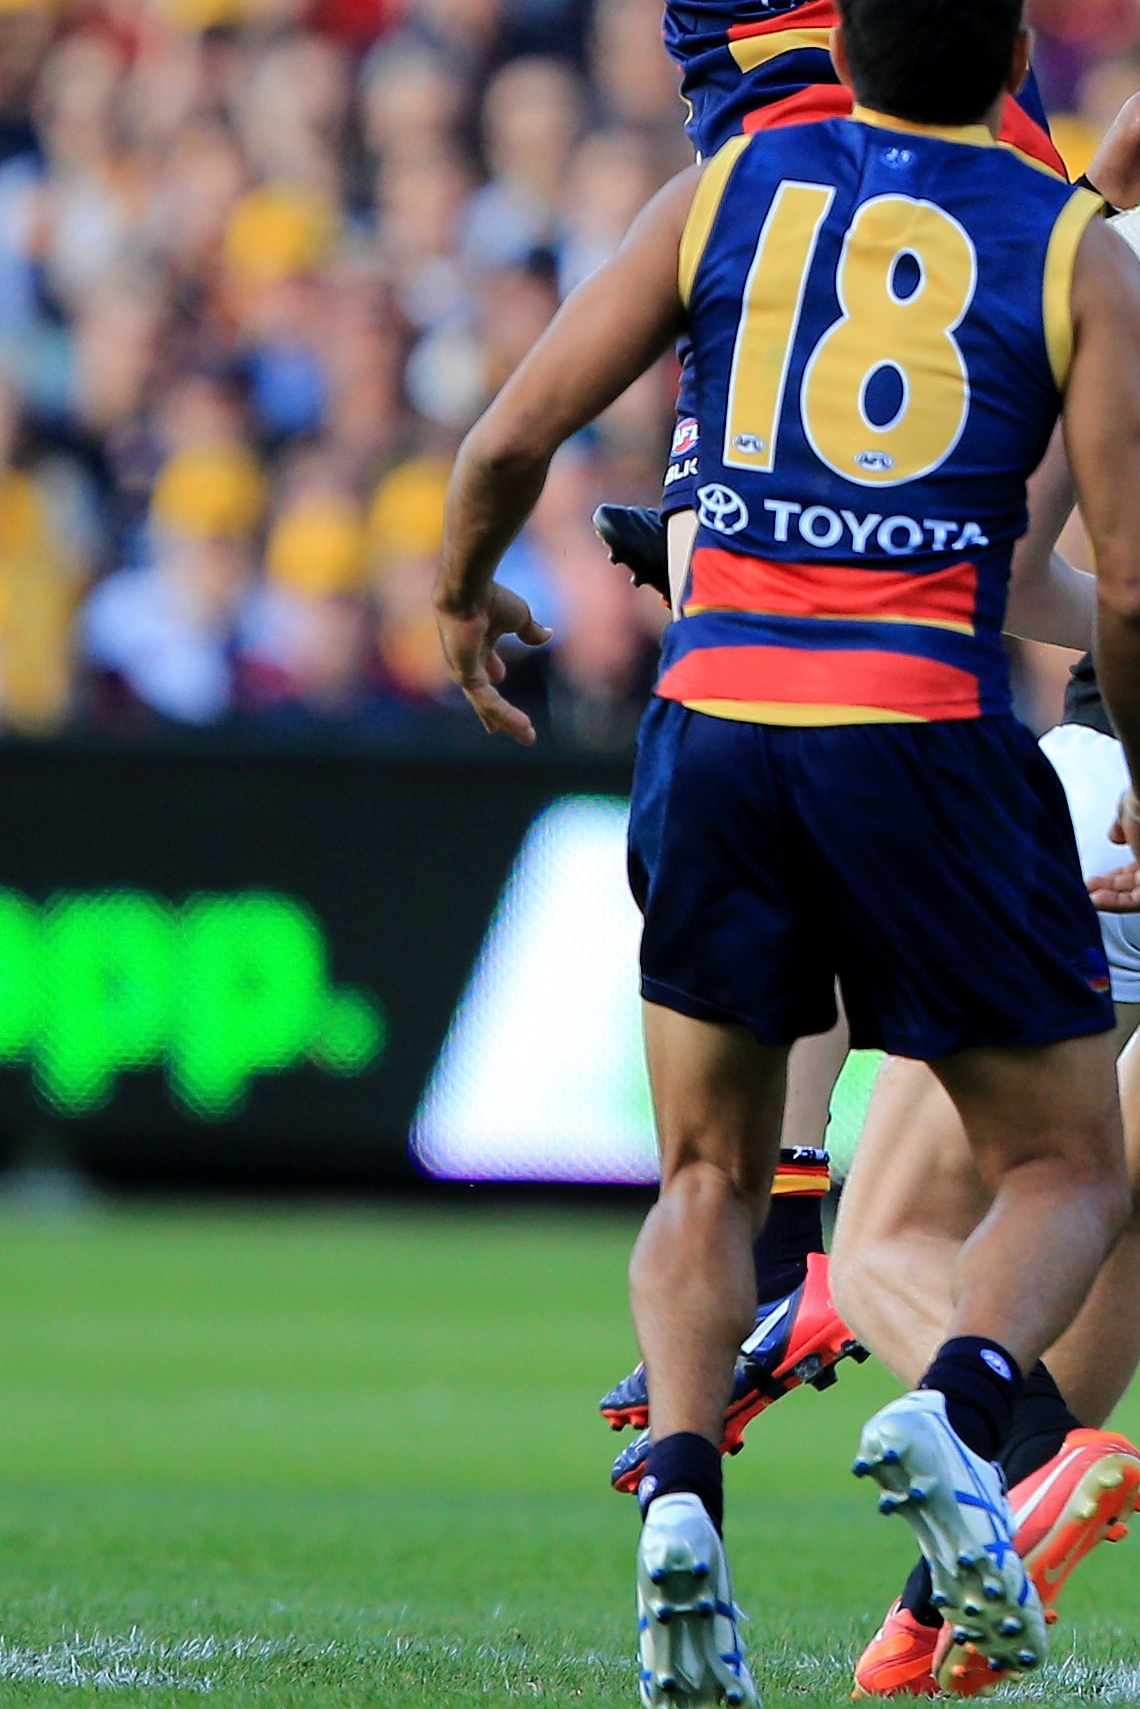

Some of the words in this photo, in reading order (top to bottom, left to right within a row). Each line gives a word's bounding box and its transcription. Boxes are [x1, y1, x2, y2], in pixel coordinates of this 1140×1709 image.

[722, 179, 978, 487] 18
[673, 422, 699, 449] AFL
[664, 457, 698, 486] BLK
[764, 499, 989, 555] TOYOTA
